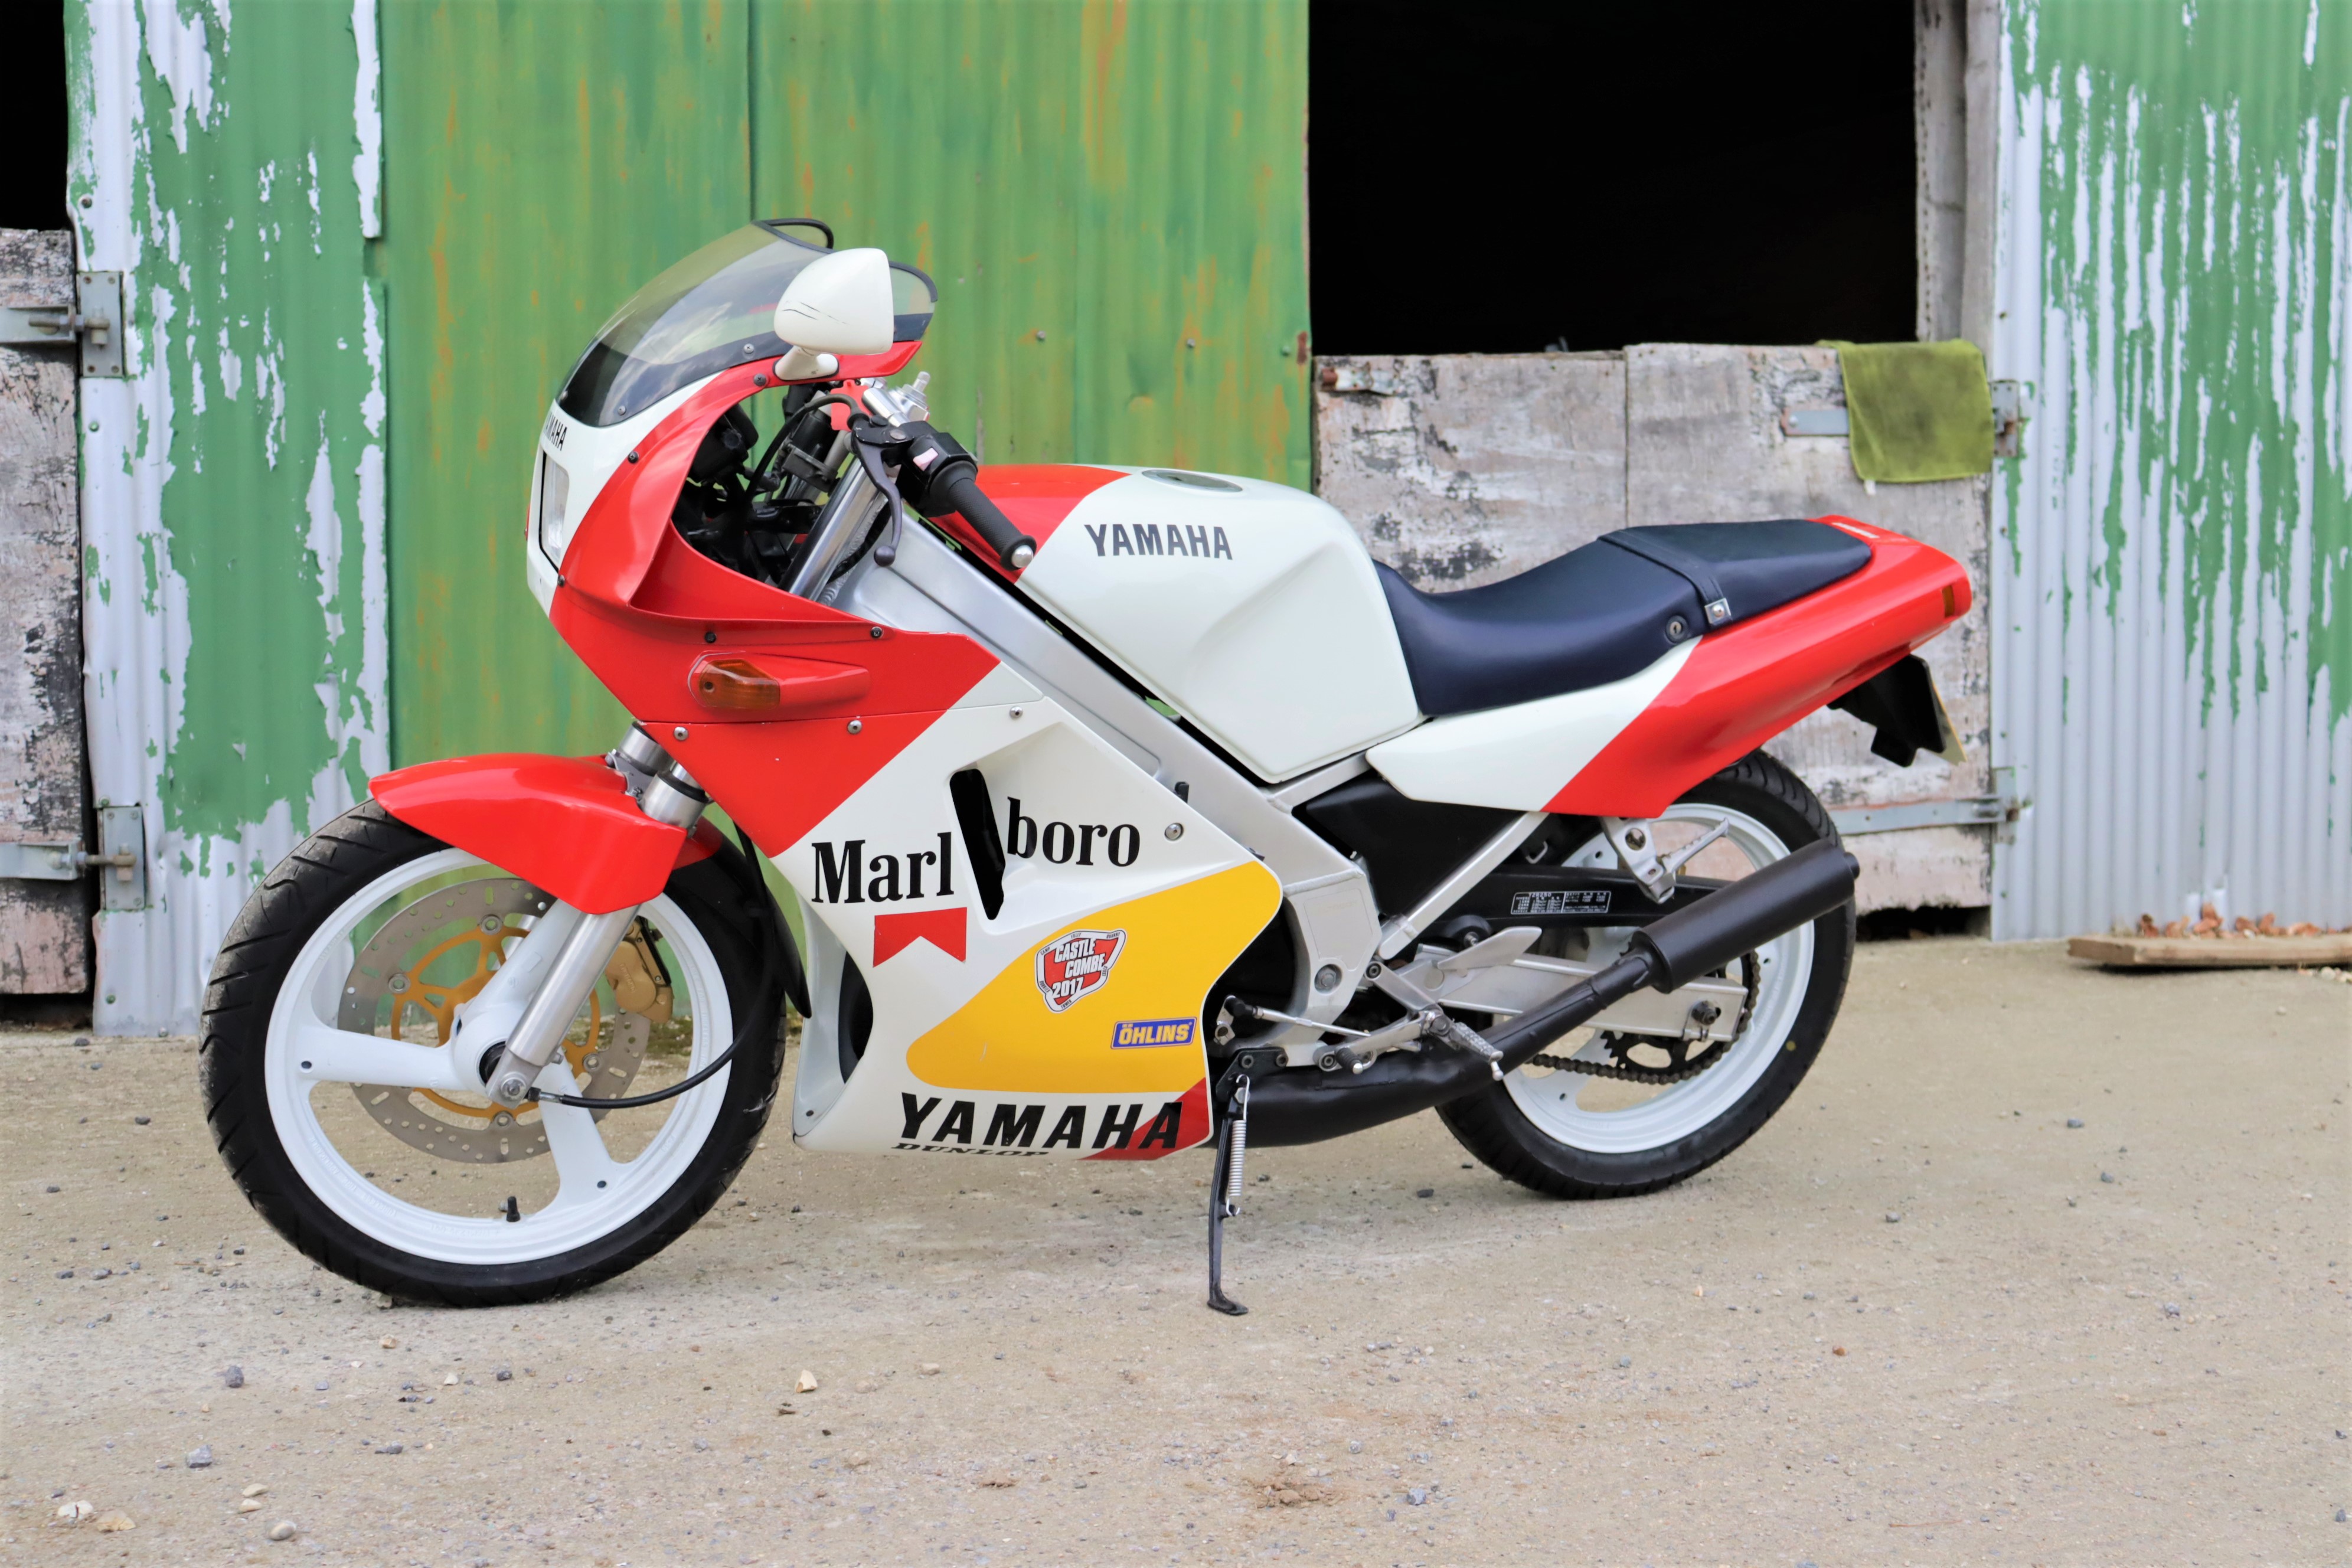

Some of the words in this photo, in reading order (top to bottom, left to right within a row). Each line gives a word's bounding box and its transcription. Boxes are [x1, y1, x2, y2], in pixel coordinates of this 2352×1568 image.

[1084, 524, 1233, 560] YAMAHA
[1054, 938, 1096, 963] CASTLE
[1064, 953, 1106, 978] COMBE
[1051, 976, 1084, 998] 2017
[901, 1092, 1182, 1149] YAMAHA
[891, 1142, 1049, 1157] DUNLOP
